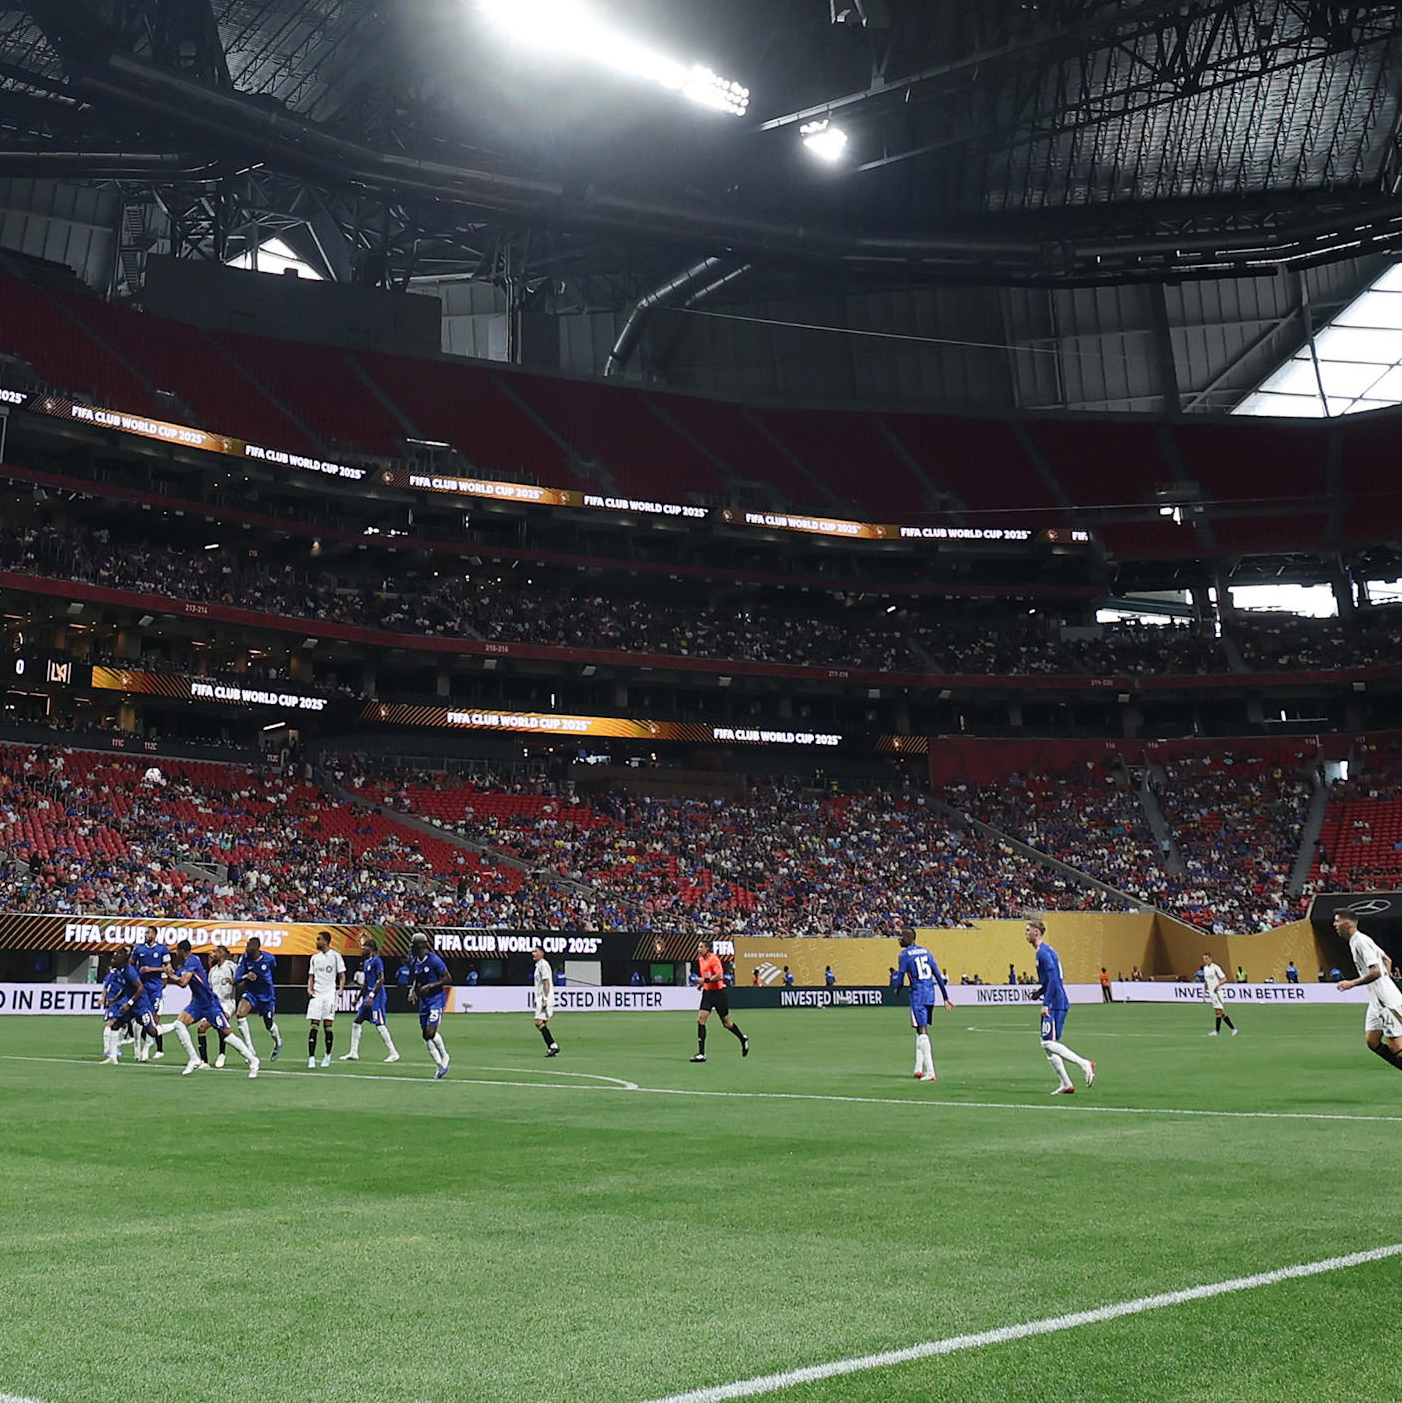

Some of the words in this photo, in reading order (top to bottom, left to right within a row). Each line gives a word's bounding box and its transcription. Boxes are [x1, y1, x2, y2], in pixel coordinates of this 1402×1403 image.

[900, 527, 921, 536] FIFA
[922, 528, 946, 537] CLUB
[947, 528, 982, 538] WORLD
[983, 529, 1002, 538] CUP
[15, 659, 25, 675] 0
[191, 683, 213, 696] FIFA
[214, 686, 240, 699] CLUB
[241, 690, 277, 704] WORLD
[278, 694, 298, 706] CUP
[713, 728, 734, 739] FIFA
[735, 729, 759, 740] CLUB
[760, 731, 794, 742] WORLD
[795, 733, 814, 743] CUP
[65, 924, 100, 942] FIFA
[104, 925, 147, 944] CLUB
[210, 928, 242, 945] CUP
[434, 934, 461, 950] FIFA
[463, 935, 495, 951] CLUB
[542, 937, 566, 952] CUP
[712, 941, 735, 955] FIFA
[914, 955, 932, 980] 15
[12, 990, 33, 1010] IN
[40, 991, 108, 1010] BETTE
[598, 992, 611, 1008] IN
[615, 992, 662, 1008] BETTER
[781, 990, 831, 1006] INVESTED
[847, 990, 882, 1005] BETTER
[1239, 988, 1251, 998] IN
[1255, 988, 1304, 998] BETTER
